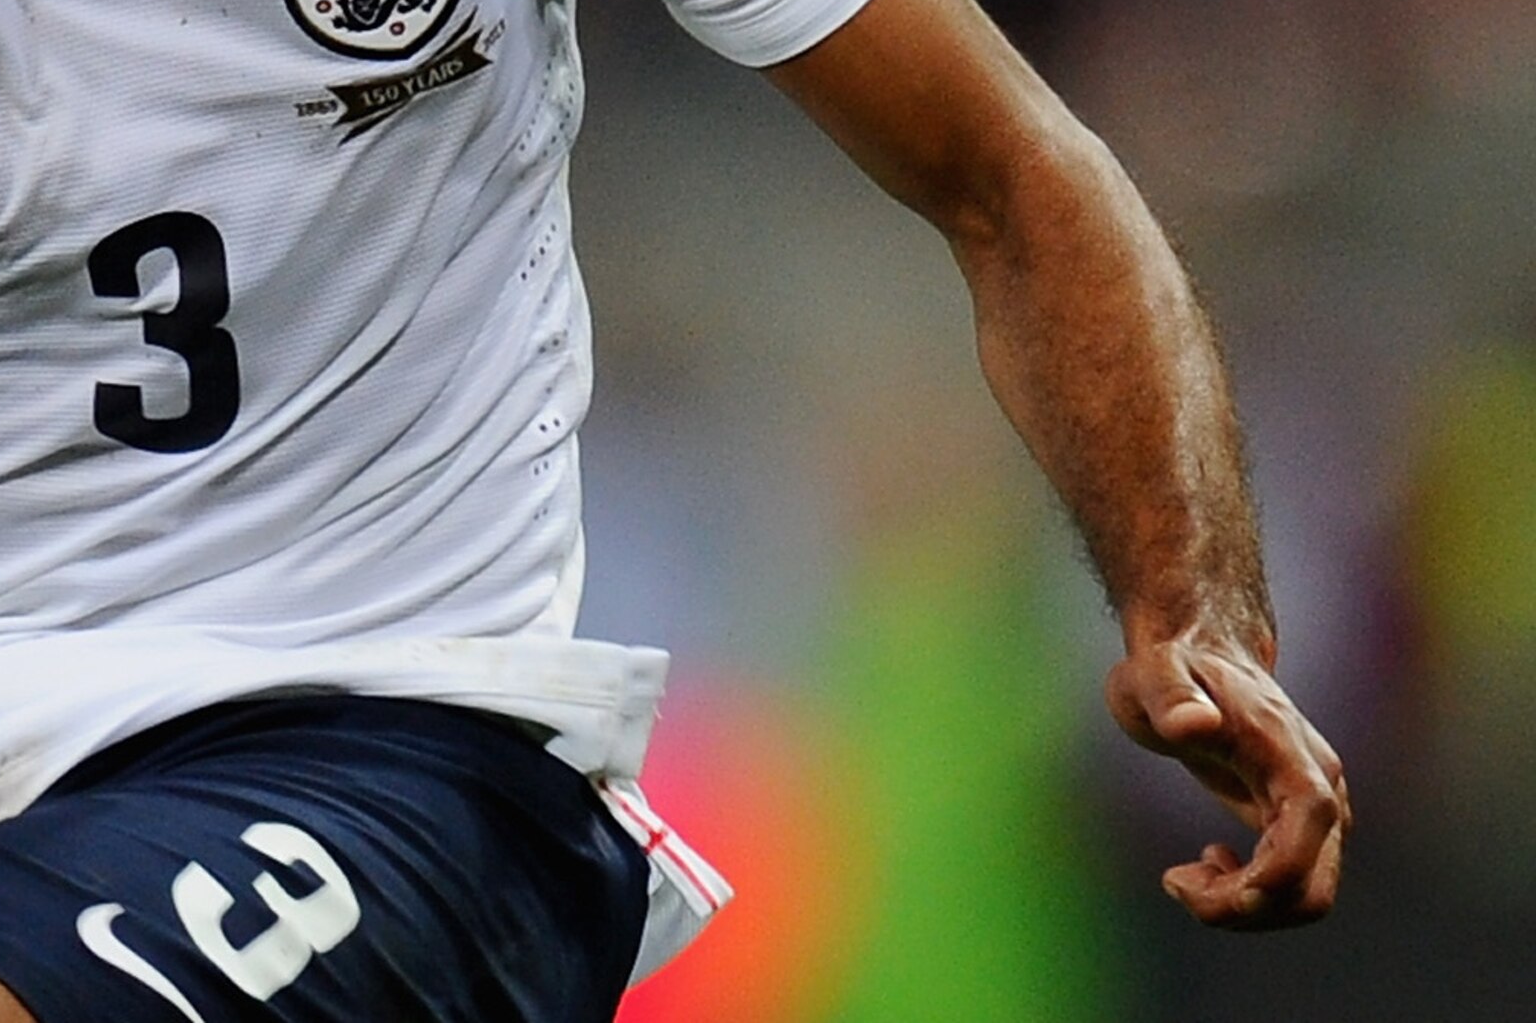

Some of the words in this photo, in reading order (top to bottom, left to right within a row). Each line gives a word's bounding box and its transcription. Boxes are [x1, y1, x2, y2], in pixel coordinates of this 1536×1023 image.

[359, 84, 400, 108] 150
[405, 59, 464, 96] YEARS
[87, 211, 240, 454] 3
[171, 821, 362, 1002] 3
